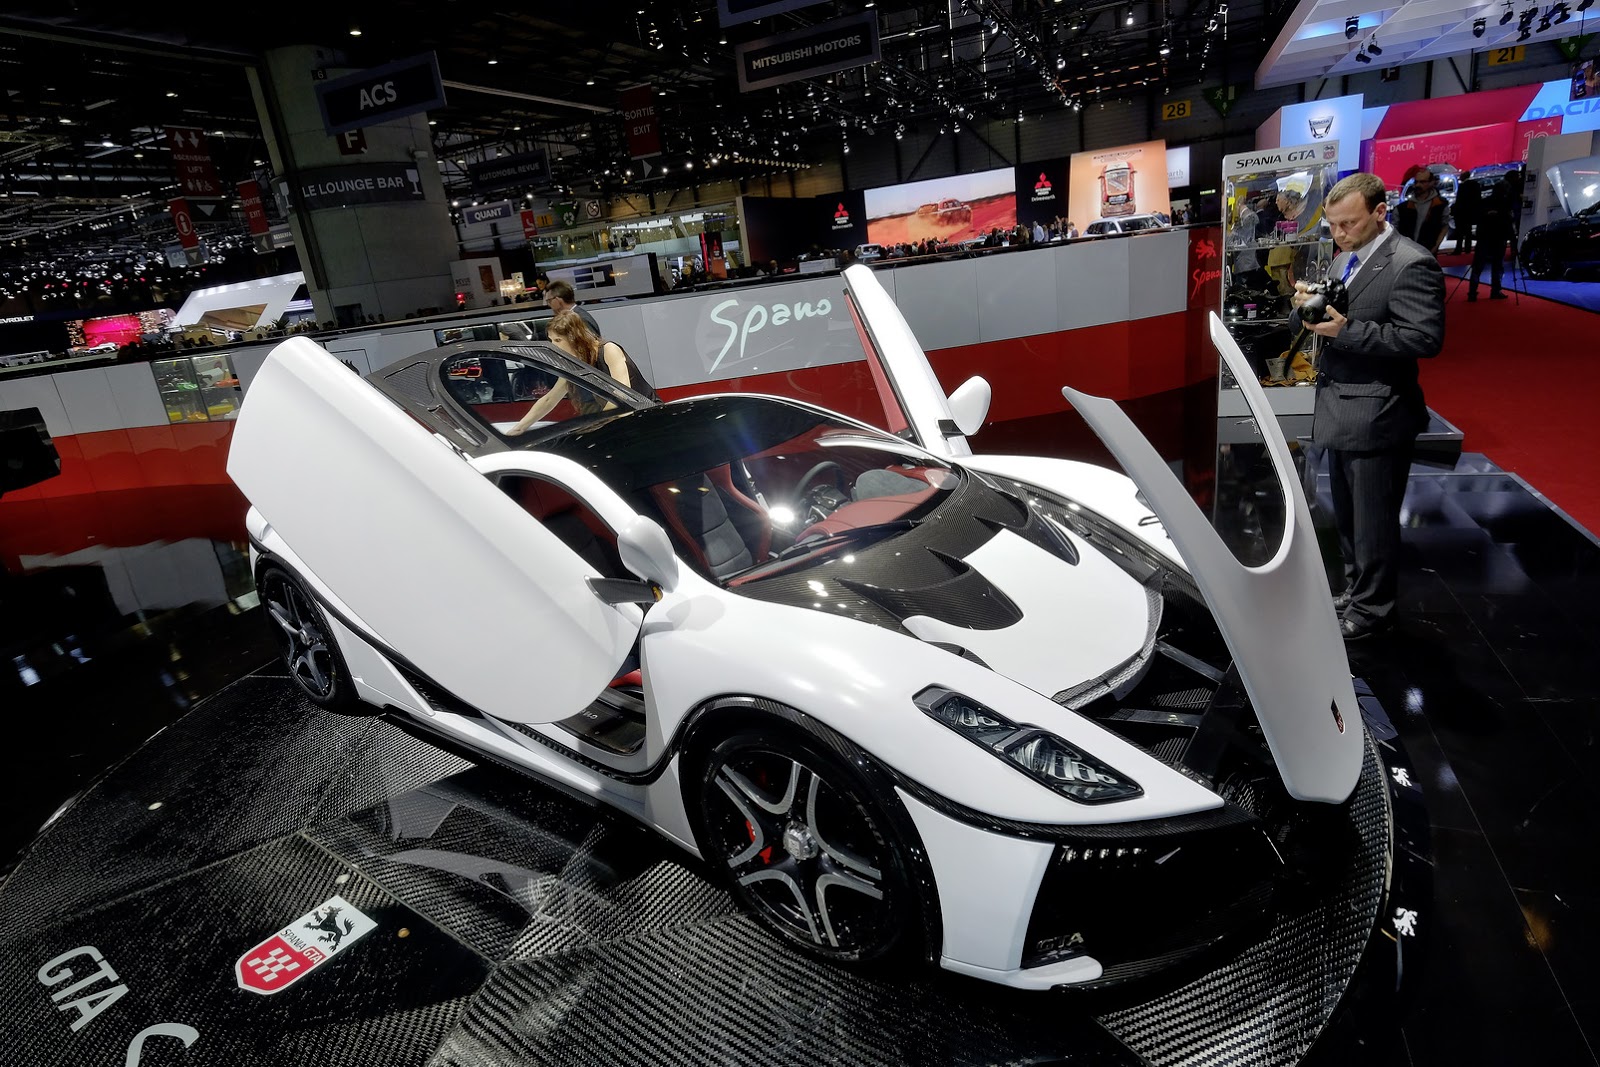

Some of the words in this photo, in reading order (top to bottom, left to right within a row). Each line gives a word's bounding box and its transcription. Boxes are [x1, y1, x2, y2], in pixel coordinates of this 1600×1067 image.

[752, 47, 812, 70] MITSUBISHI
[815, 35, 862, 54] MOTORS
[1497, 48, 1516, 63] 21
[359, 81, 397, 111] ACS
[624, 106, 655, 121] SORTIE
[1166, 102, 1186, 118] 28
[633, 124, 651, 136] EXIT
[344, 130, 359, 149] F
[1389, 142, 1415, 153] DACIA
[1235, 154, 1282, 170] SPANIA
[1287, 149, 1316, 162] GTA
[1428, 151, 1457, 163] Erfolg
[186, 166, 204, 174] LIFT
[478, 168, 517, 182] AUTOMOBIL
[517, 162, 540, 174] REVUE
[302, 185, 317, 198] LE
[319, 178, 375, 195] LOUNGE
[376, 176, 405, 190] BAR
[249, 209, 261, 219] EXIT
[473, 207, 502, 222] QUANT
[541, 215, 548, 225] 11
[709, 299, 832, 375] Spano
[280, 929, 307, 951] SPANIA
[302, 947, 323, 965] GTA
[37, 945, 130, 1034] GTA
